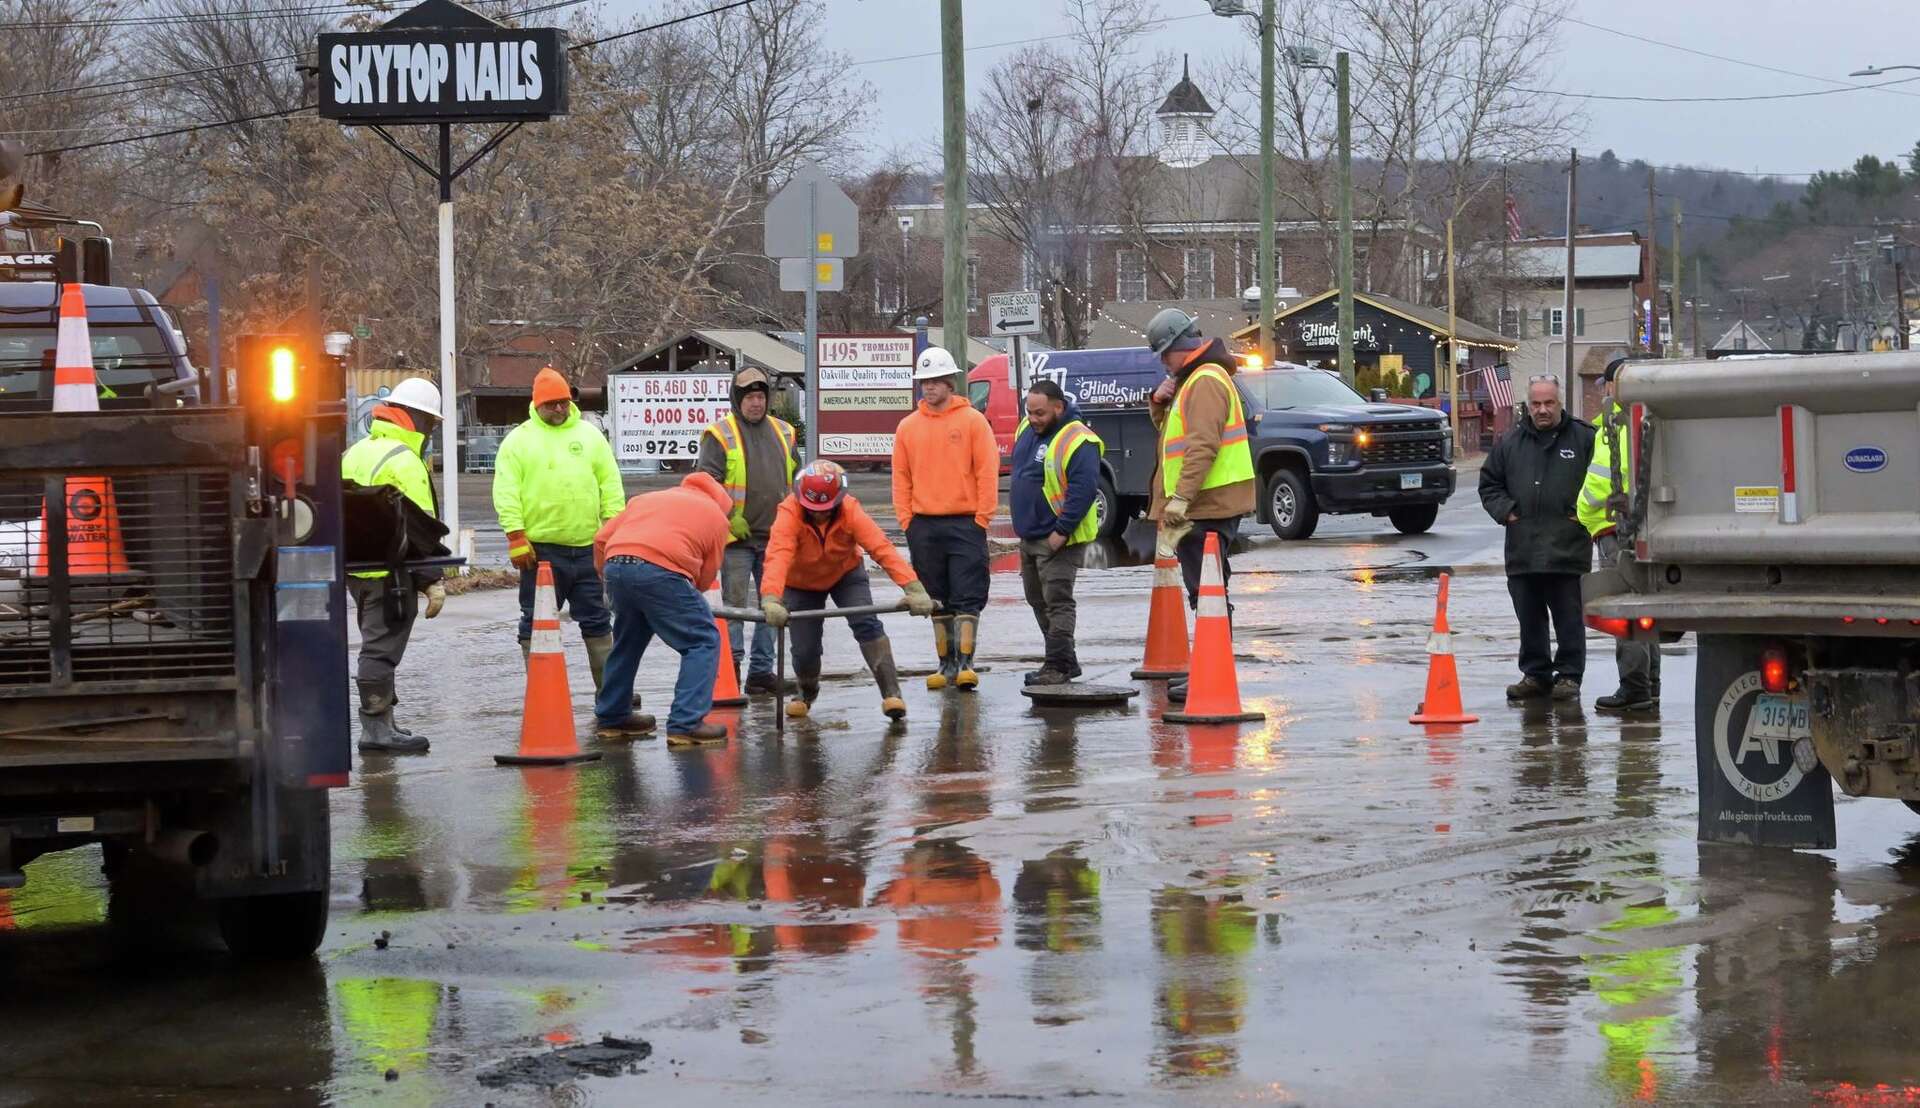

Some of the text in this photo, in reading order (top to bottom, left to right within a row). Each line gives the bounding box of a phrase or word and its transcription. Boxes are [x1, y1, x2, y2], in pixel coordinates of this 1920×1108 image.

[330, 39, 543, 104] SKYTOP NAILS
[1016, 294, 1037, 305] SCHOOL
[1000, 305, 1028, 317] ENTRANCE
[822, 342, 858, 361] 1495
[862, 343, 910, 352] THOMASTON
[870, 352, 901, 361] AVENUE
[821, 368, 911, 381] Oakville Quality Products
[645, 380, 687, 396] 66,460
[693, 380, 711, 397] SQ.
[823, 396, 909, 405] AMERICAN PLASTIC PRODUCTS
[644, 408, 682, 427] 8,000
[688, 408, 709, 424] SQ.
[621, 429, 655, 437] INDUSTRIAL
[622, 443, 643, 454] (203)
[826, 440, 848, 449] SMS
[1739, 777, 1791, 798] TRUCKS
[1719, 810, 1813, 824] AllegianceTrucks.com
